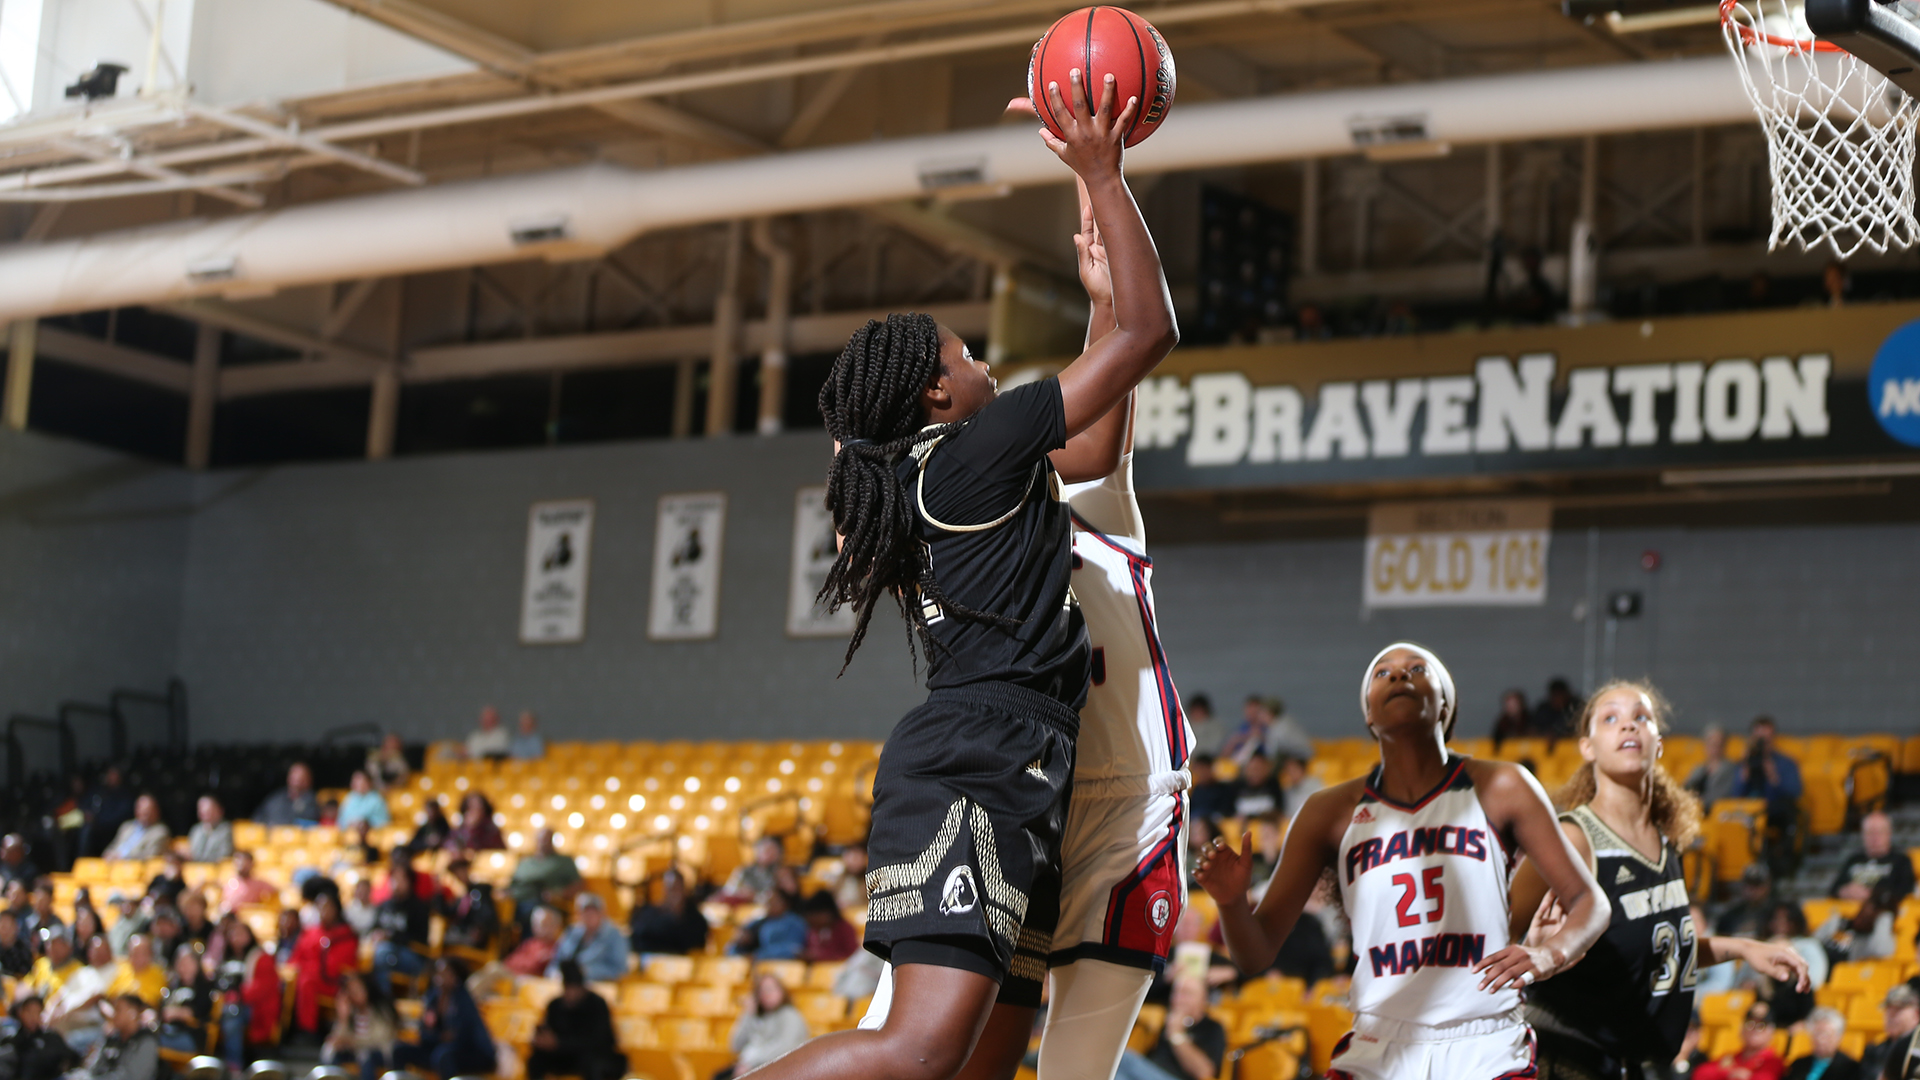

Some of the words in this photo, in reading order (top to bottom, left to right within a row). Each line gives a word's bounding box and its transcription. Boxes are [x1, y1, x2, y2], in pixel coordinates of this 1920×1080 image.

[1373, 536, 1473, 594] GOLD
[1486, 535, 1542, 592] 103
[1346, 825, 1487, 886] FRANCIS
[1392, 865, 1445, 929] 25
[1651, 914, 1699, 997] 32
